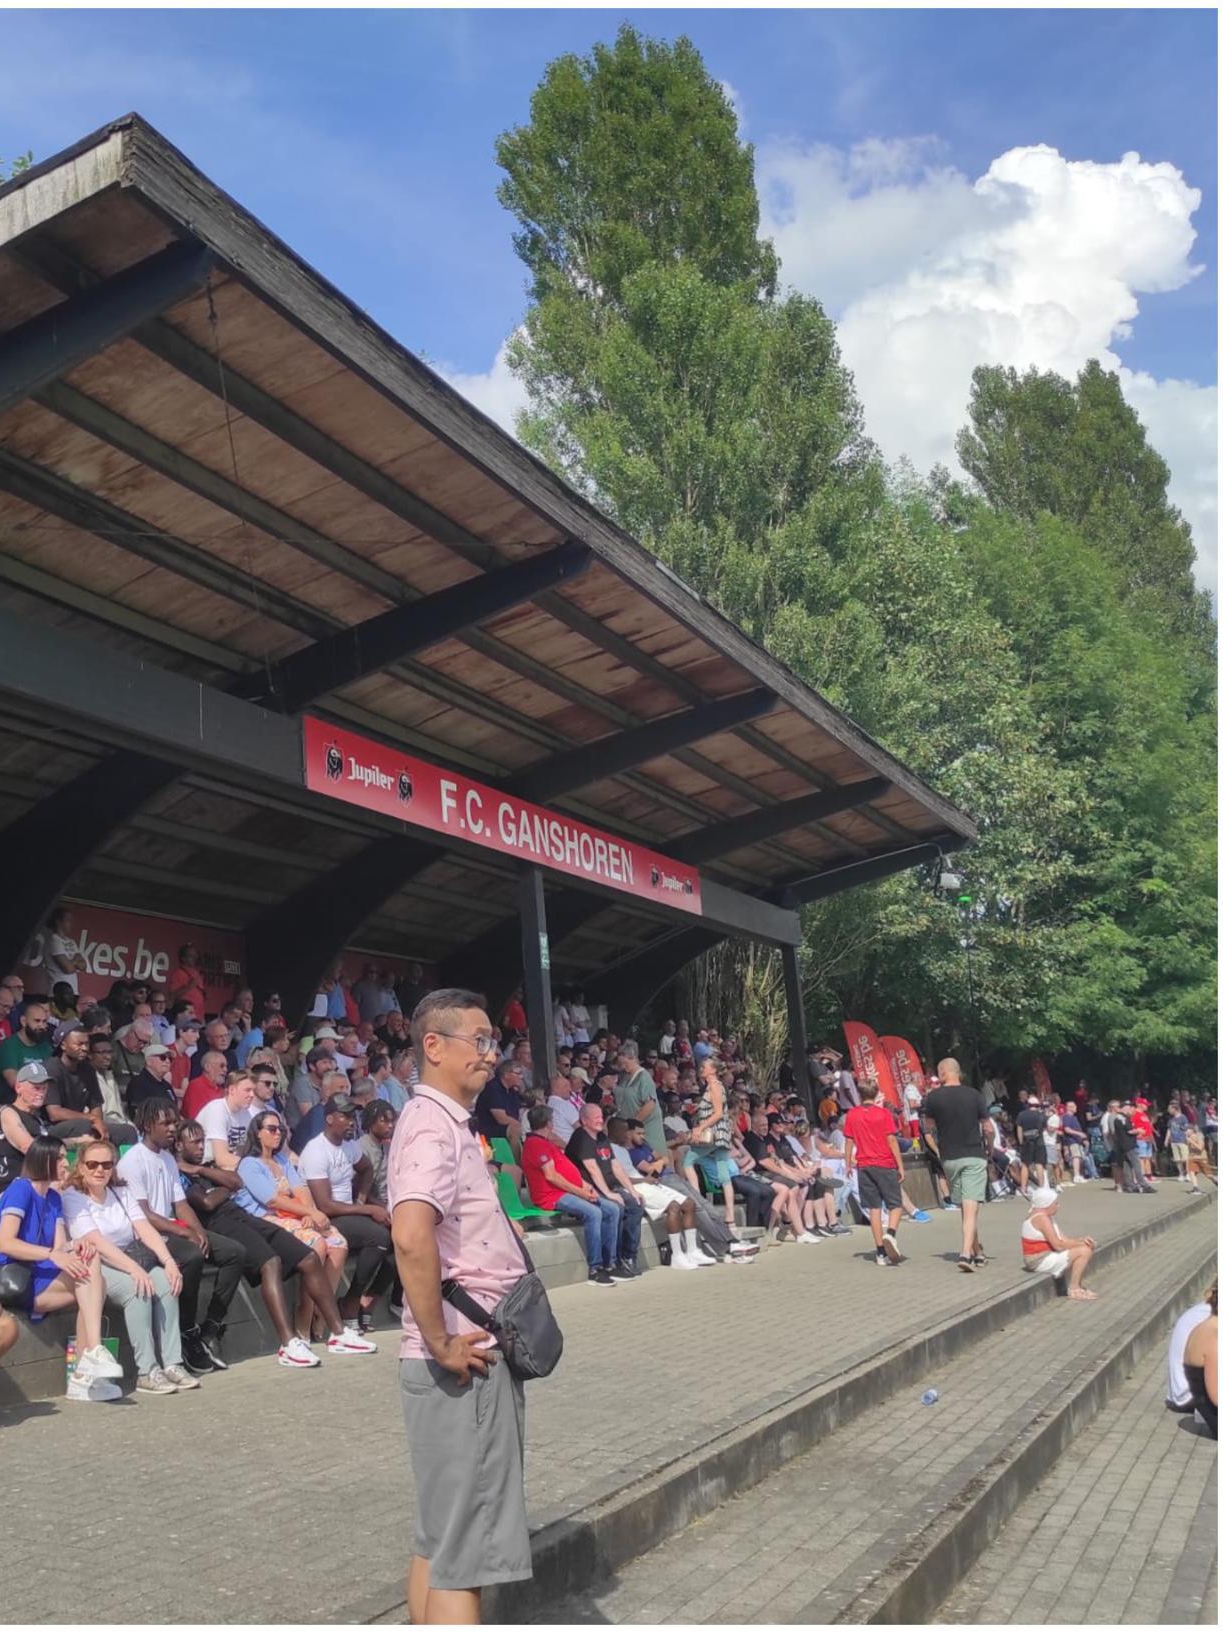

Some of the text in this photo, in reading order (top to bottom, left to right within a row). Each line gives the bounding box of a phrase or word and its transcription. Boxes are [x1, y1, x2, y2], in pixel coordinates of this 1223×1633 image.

[347, 757, 395, 791] Jupiler
[440, 778, 634, 885] F.C. GANSHOREN
